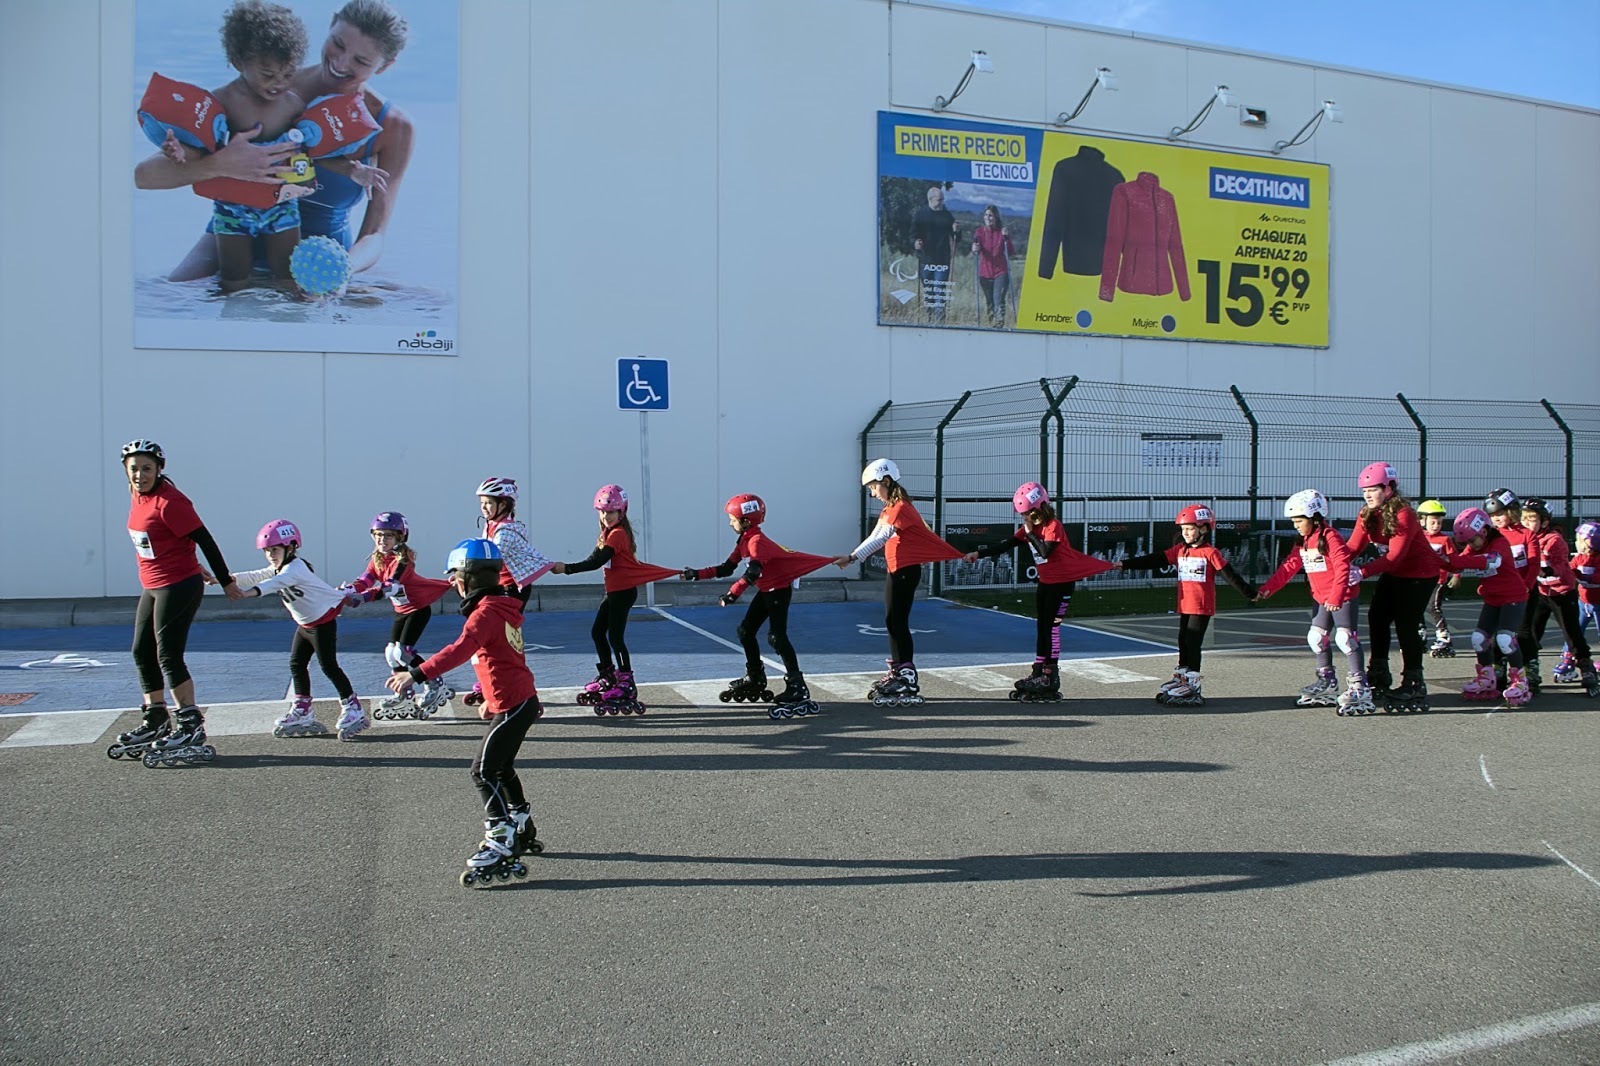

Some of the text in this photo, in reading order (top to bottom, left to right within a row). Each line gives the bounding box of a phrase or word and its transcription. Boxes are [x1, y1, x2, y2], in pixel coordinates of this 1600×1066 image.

[901, 132, 1021, 158] PRIMER PRECIO
[1214, 174, 1305, 202] DECATHLON
[1272, 215, 1306, 224] Quechua
[1241, 227, 1307, 246] CHAQUETA
[1235, 245, 1307, 262] ARPENAZ 20
[923, 264, 949, 272] ADOP
[1292, 302, 1310, 312] PVP
[1035, 313, 1073, 324] Hombre:
[1132, 318, 1159, 329] Mujer:
[398, 338, 453, 352] nabaiji
